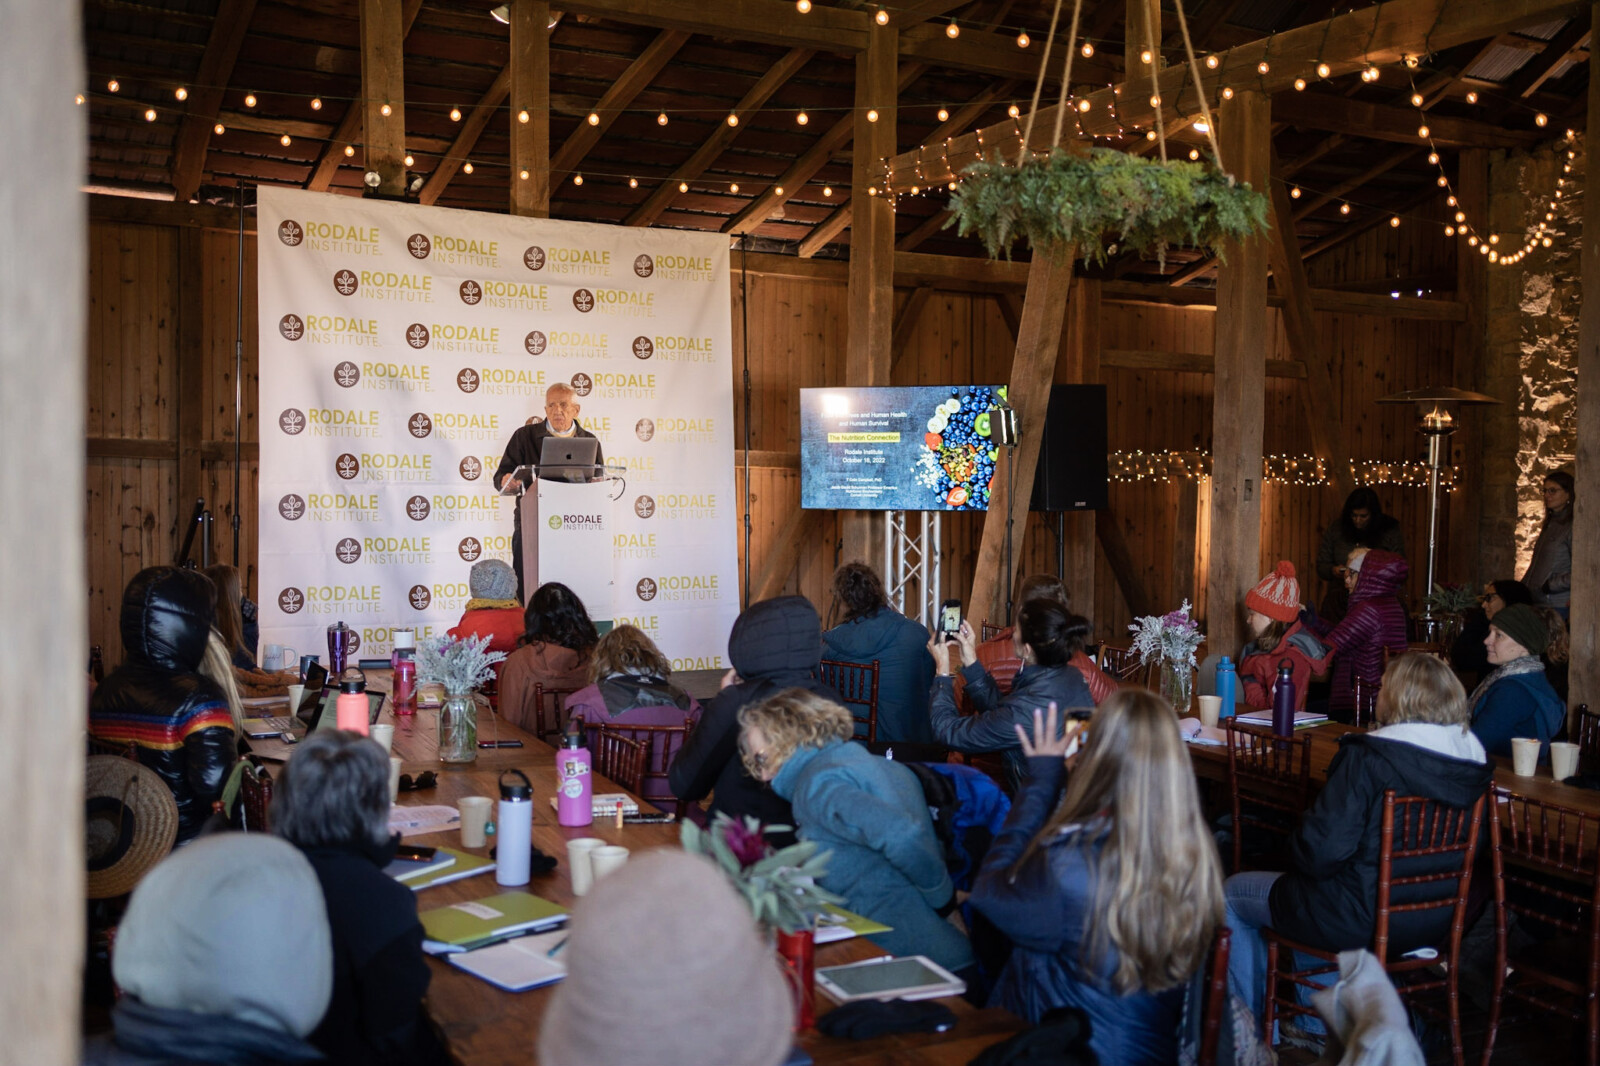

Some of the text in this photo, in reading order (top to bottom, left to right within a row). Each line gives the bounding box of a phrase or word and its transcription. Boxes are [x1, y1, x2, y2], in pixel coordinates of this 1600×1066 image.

[306, 222, 379, 243] RODALE
[306, 240, 379, 256] INSTITUTE
[433, 235, 498, 256] RODALE
[433, 252, 498, 268] INSTITUTE
[548, 248, 610, 265] RODALE
[655, 255, 712, 271] RODALE
[547, 263, 610, 277] INSTITUTE
[656, 269, 713, 282] INSTITUTE
[361, 271, 432, 290] RODALE
[360, 288, 432, 303] INSTITUTE
[484, 281, 548, 299] RODALE
[596, 289, 654, 306] RODALE
[484, 297, 549, 311] INSTITUTE
[596, 304, 654, 317] INSTITUTE
[306, 315, 378, 335] RODALE
[307, 332, 378, 347] INSTITUTE
[432, 324, 499, 342] RODALE
[549, 331, 608, 348] RODALE
[432, 341, 499, 354] INSTITUTE
[655, 336, 712, 351] RODALE
[547, 346, 610, 359] INSTITUTE
[655, 350, 713, 363] INSTITUTE
[363, 362, 430, 380] RODALE
[482, 368, 545, 385] RODALE
[362, 379, 430, 392] INSTITUTE
[594, 373, 656, 388] RODALE
[482, 384, 546, 396] INSTITUTE
[595, 387, 656, 399] INSTITUTE
[308, 408, 379, 426] RODALE
[433, 413, 499, 429] RODALE
[308, 425, 379, 438] INSTITUTE
[656, 418, 714, 432] RODALE
[434, 429, 500, 440] INSTITUTE
[361, 453, 432, 469] RODALE
[605, 456, 655, 471] ODALE
[361, 469, 432, 481] INSTITUTE
[308, 494, 379, 510] RODALE
[433, 495, 500, 510] RODALE
[657, 494, 716, 508] RODALE
[308, 510, 378, 522] INSTITUTE
[432, 511, 500, 522] INSTITUTE
[563, 515, 602, 523] RODALE
[657, 509, 717, 519] INSTITUTE
[364, 537, 430, 552] RODALE
[613, 533, 656, 547] DALE
[364, 553, 431, 564] INSTITUTE
[613, 548, 657, 559] TITUTE
[659, 575, 719, 590] RODALE
[307, 585, 381, 602] RODALE
[433, 584, 468, 598] ROD
[659, 589, 719, 601] INSTITUTE
[306, 602, 381, 614] INSTITUTE
[671, 656, 721, 671] ODALE
